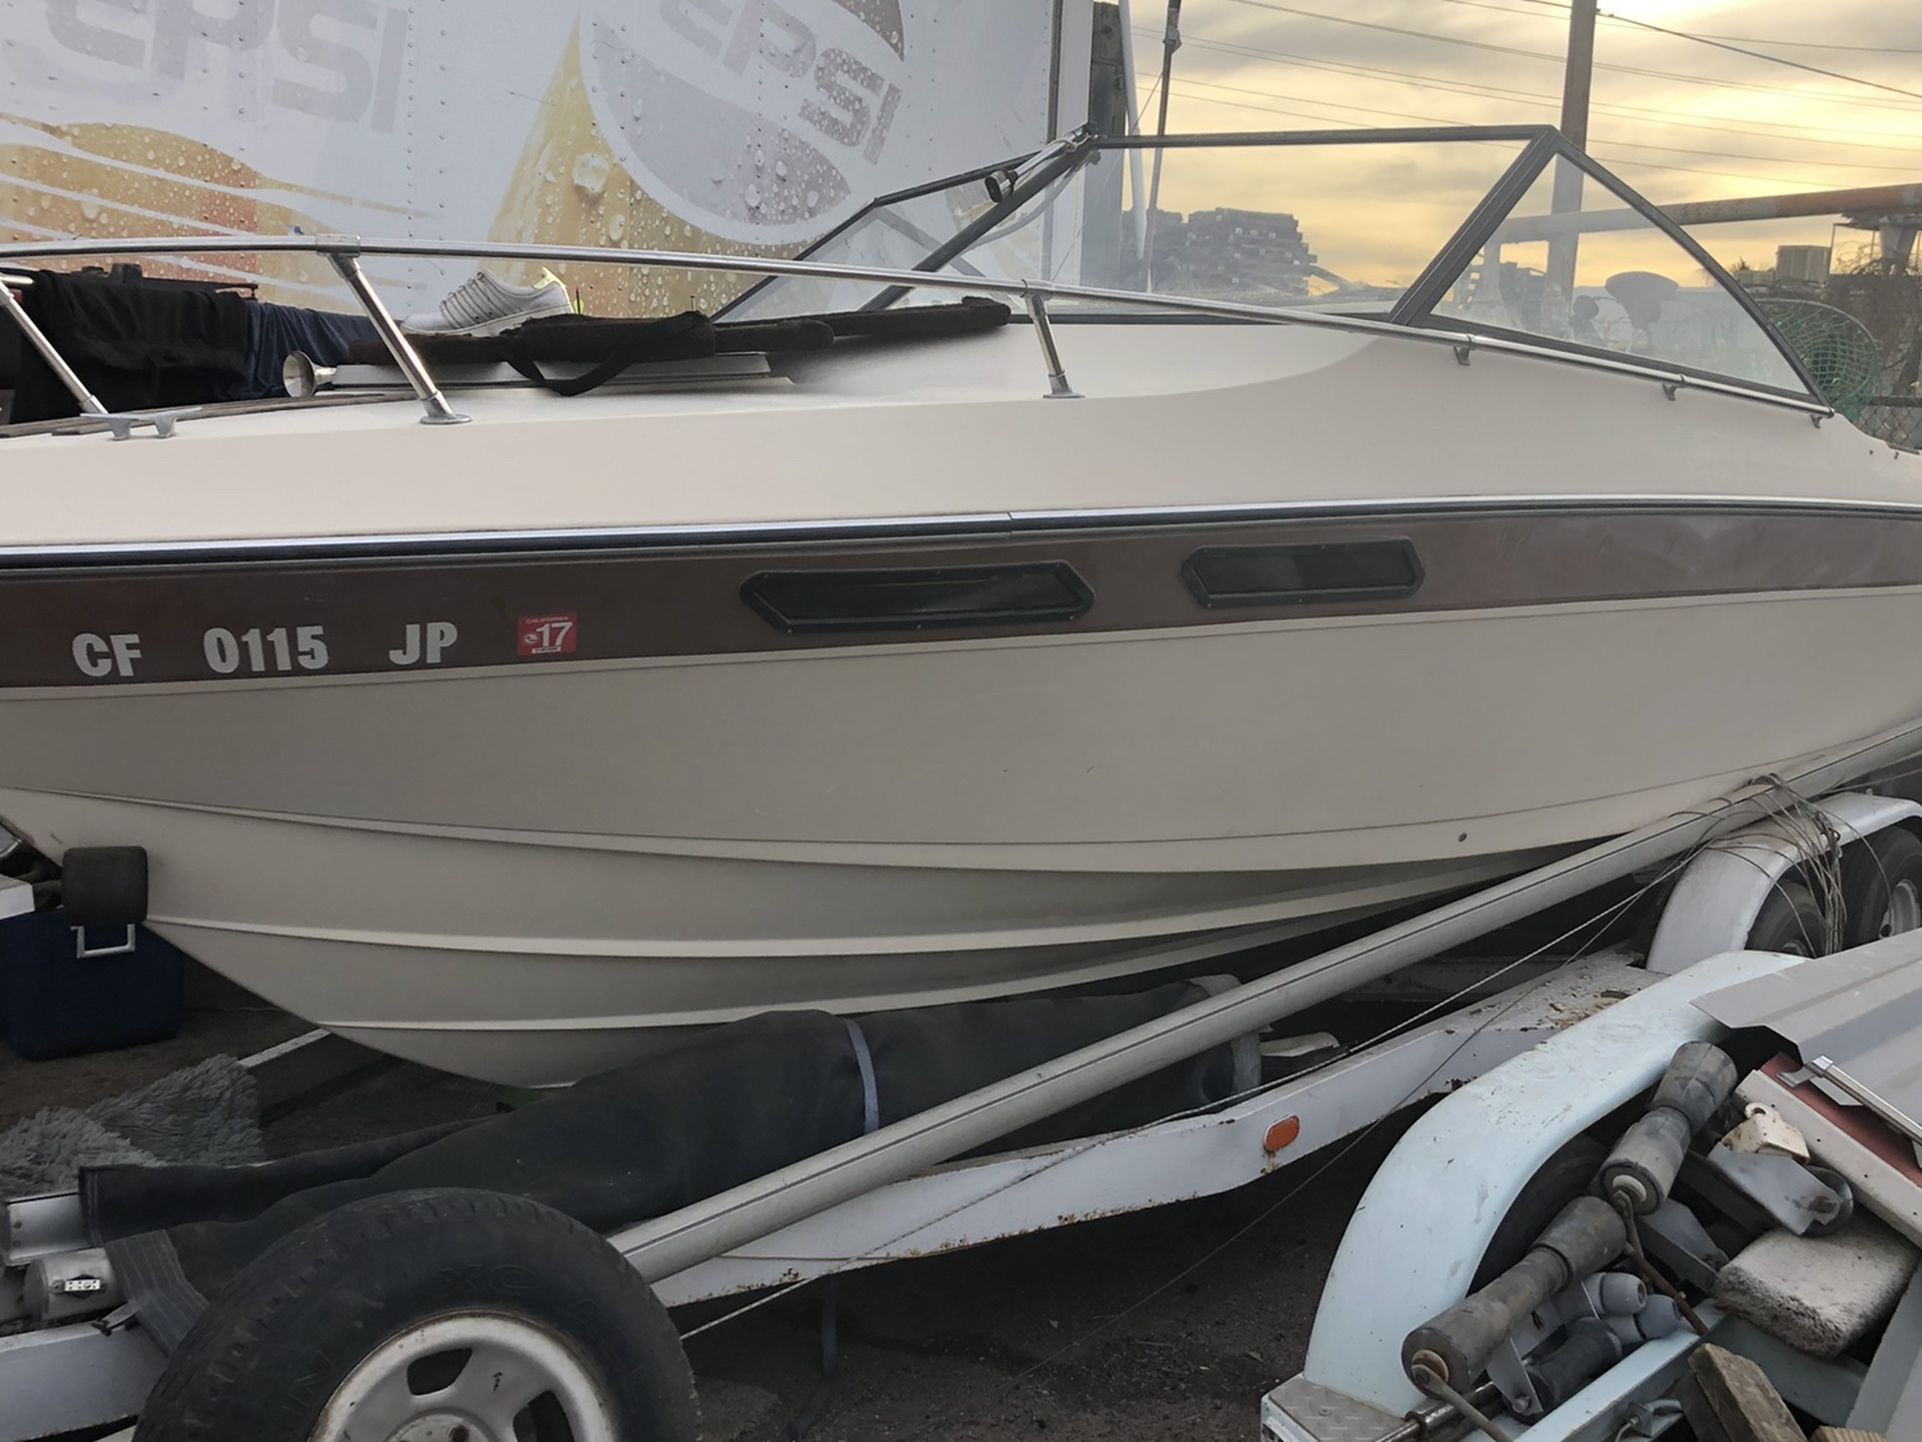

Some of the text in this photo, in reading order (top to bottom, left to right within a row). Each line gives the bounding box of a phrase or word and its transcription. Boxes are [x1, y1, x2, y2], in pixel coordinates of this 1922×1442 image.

[72, 621, 458, 677] CF 0115 JP
[536, 622, 573, 648] 17
